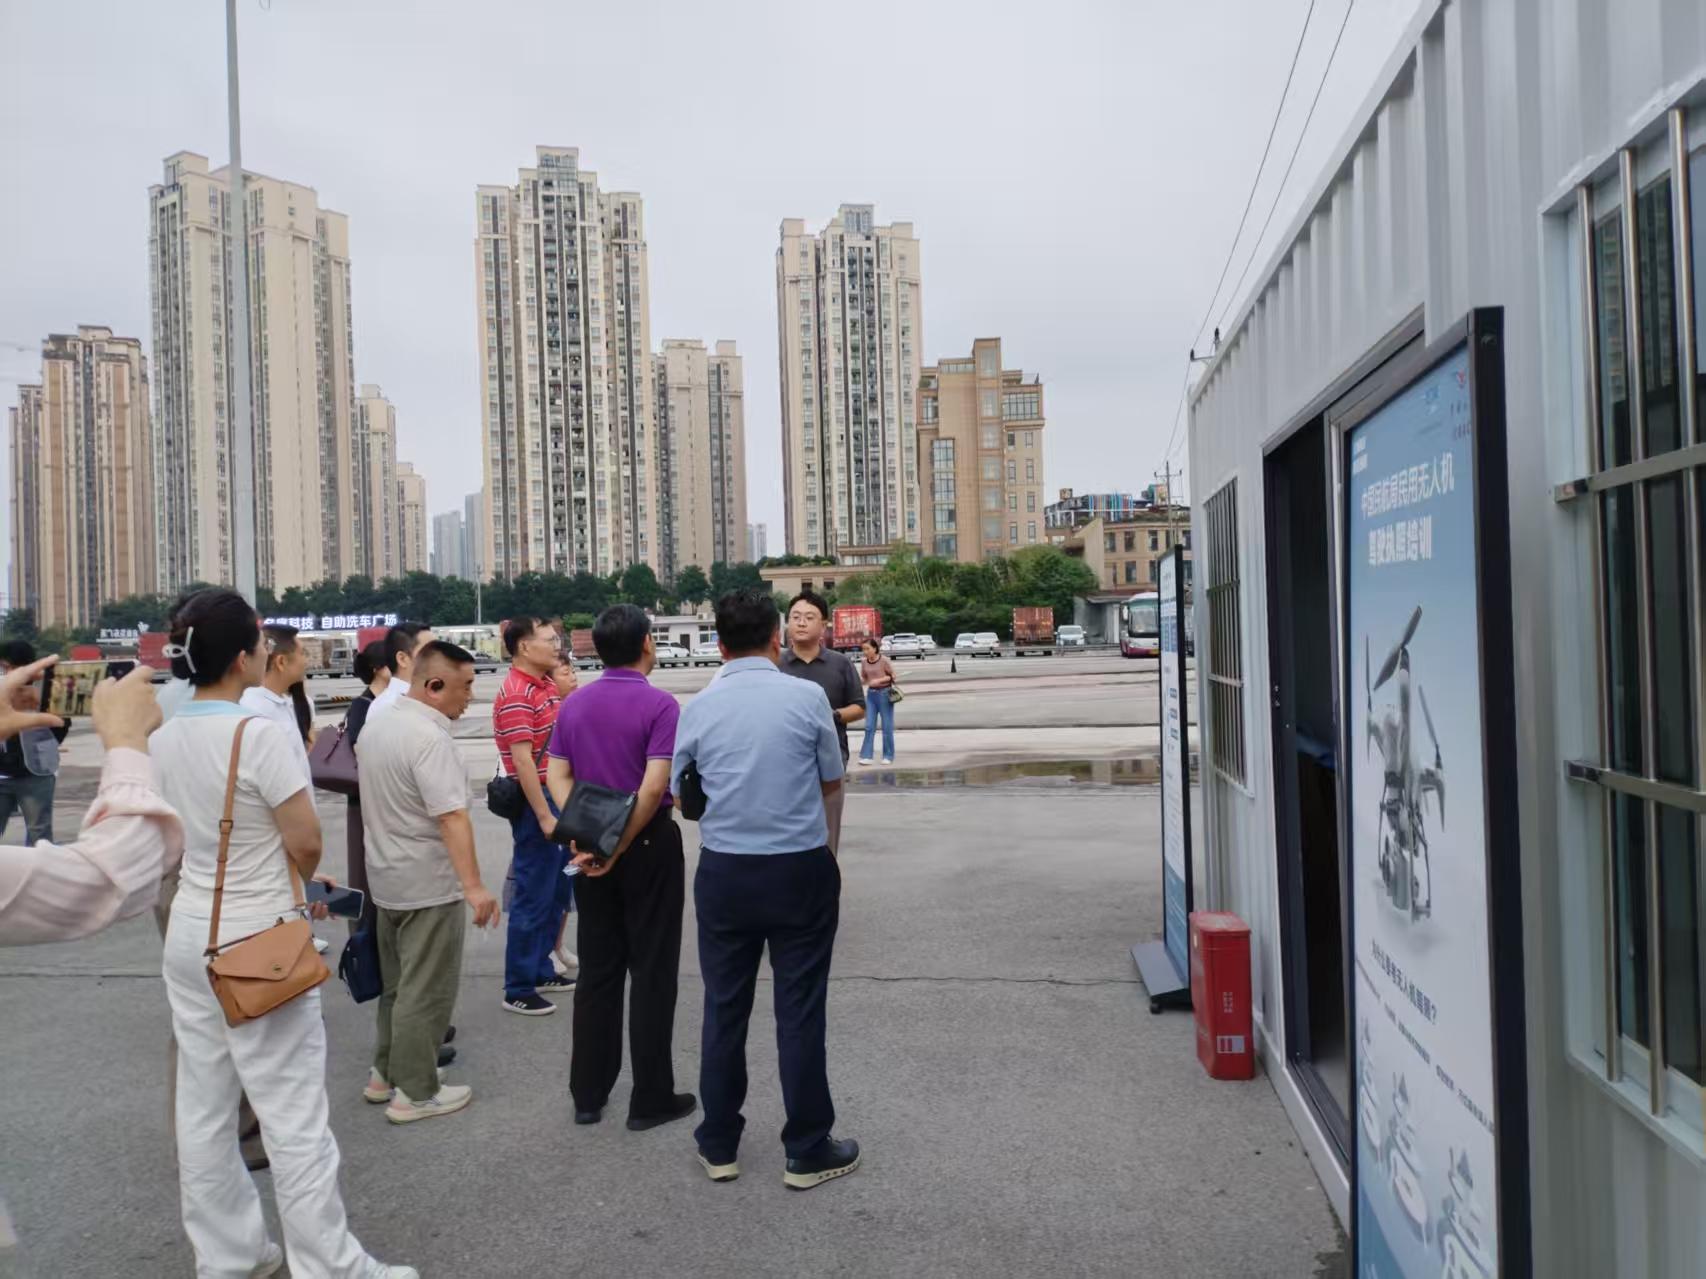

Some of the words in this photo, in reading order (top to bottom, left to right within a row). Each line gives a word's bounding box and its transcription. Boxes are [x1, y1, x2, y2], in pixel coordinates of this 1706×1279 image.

[1361, 450, 1455, 520] 中国民航局民用无人机
[1368, 514, 1433, 567] 驾驶执照培训
[321, 613, 398, 630] 自助洗车广场
